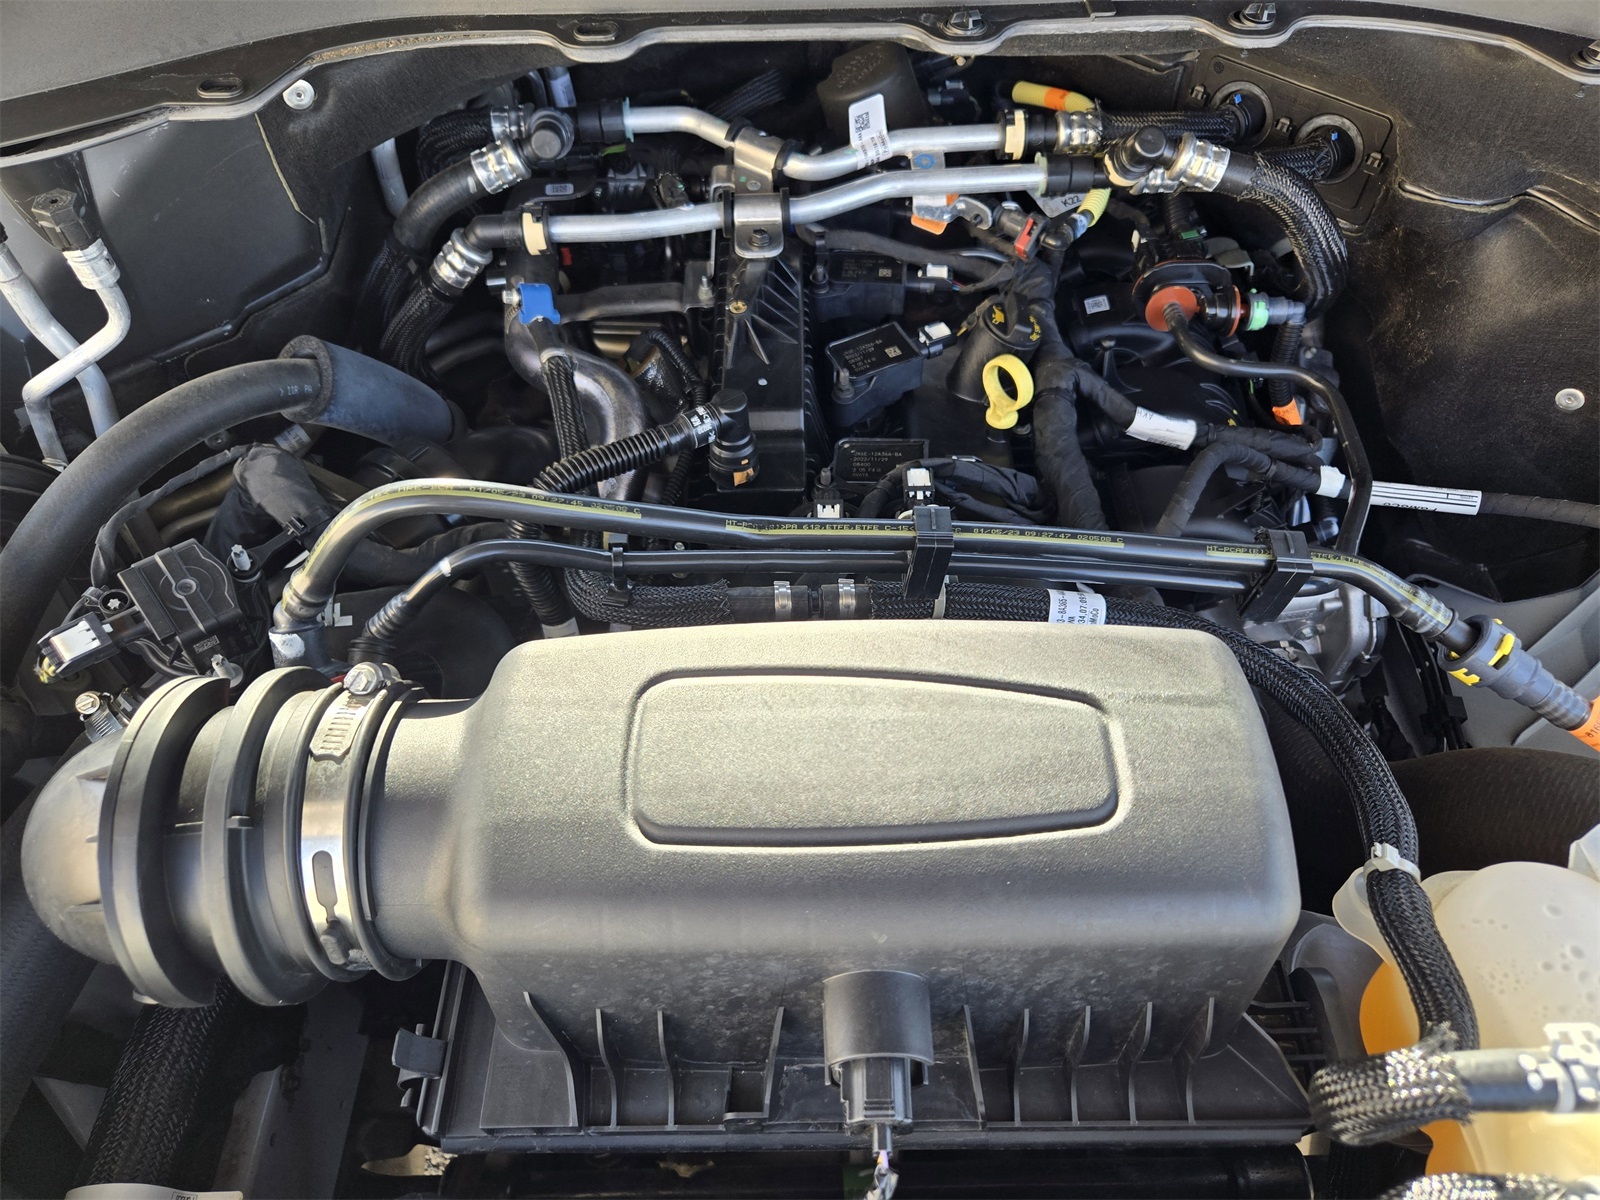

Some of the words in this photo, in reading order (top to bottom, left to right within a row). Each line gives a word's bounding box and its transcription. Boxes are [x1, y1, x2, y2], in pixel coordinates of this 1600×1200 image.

[1061, 195, 1082, 207] K22
[469, 486, 526, 498] 01/05/23
[973, 527, 1020, 536] 01/05/23
[1024, 530, 1071, 539] 09:27:47
